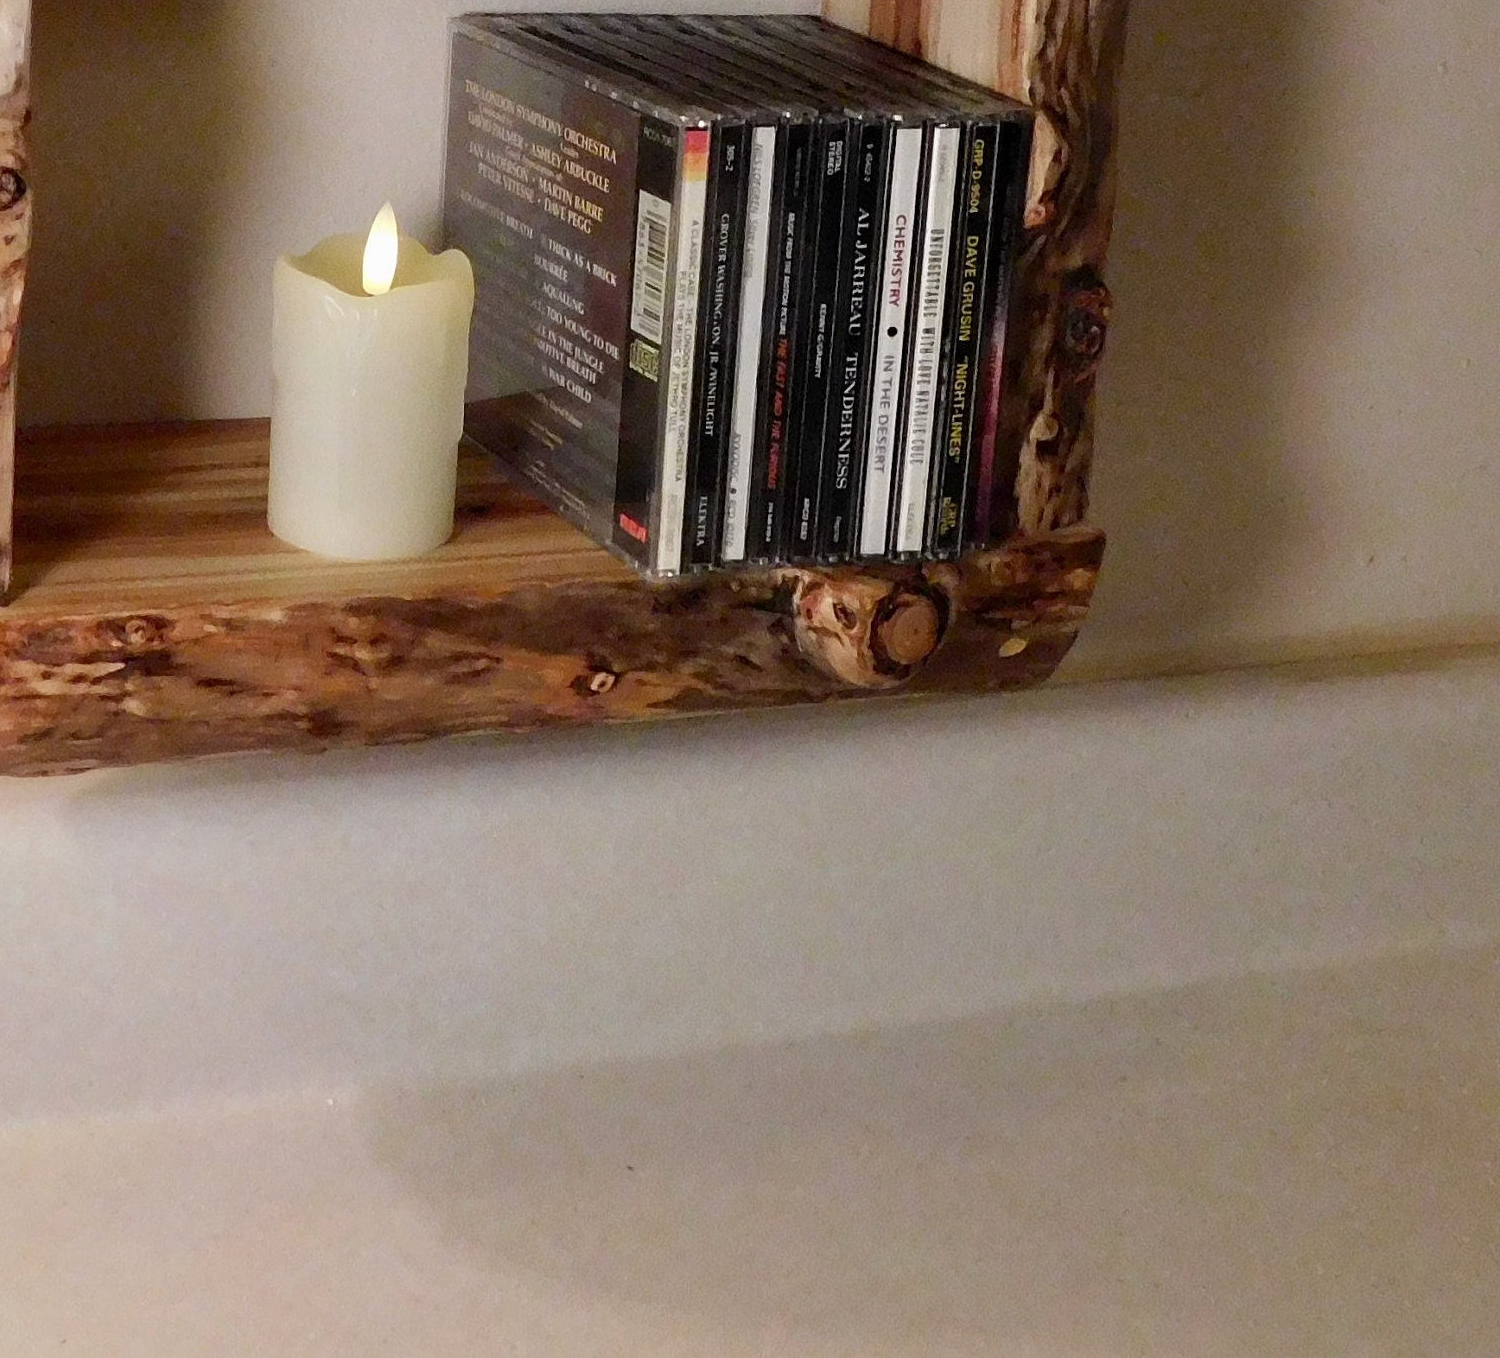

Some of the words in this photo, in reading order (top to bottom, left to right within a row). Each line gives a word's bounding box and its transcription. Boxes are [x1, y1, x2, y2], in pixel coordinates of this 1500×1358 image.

[482, 88, 515, 115] LONDON
[517, 103, 562, 136] SYMPHONY
[564, 127, 617, 164] ORCHESTRA
[493, 123, 524, 149] PALMER
[532, 144, 562, 167] ASHLEY
[563, 160, 610, 193] ARBUCKLE
[725, 145, 735, 172] 305-2
[826, 141, 836, 176] STEREO
[834, 141, 843, 173] DIGITAL
[969, 139, 985, 214] GRP-D-9504
[539, 177, 573, 206] MARTIN
[574, 196, 604, 222] BARRE
[544, 198, 567, 222] DAVE
[567, 210, 593, 235] PEGG
[786, 213, 796, 236] MUSIC
[856, 207, 870, 236] AL
[689, 229, 699, 269] CLASSIC
[718, 214, 730, 261] GROVER
[785, 238, 794, 259] FROM
[549, 239, 572, 262] THICK
[573, 252, 584, 267] AS
[586, 261, 591, 272] A
[592, 263, 618, 287] BRICK
[784, 261, 792, 274] THE
[889, 215, 907, 308] CHEMISTRY
[964, 236, 979, 278] DAVE
[677, 271, 688, 300] PLAYS
[686, 273, 696, 297] CASE
[848, 240, 868, 336] JARREAU
[923, 229, 945, 318] UNFORGETTABLE
[542, 282, 585, 315] AQUALUNG
[781, 276, 791, 306] MOTION
[676, 304, 686, 322] THE
[684, 307, 694, 326] THE
[779, 307, 789, 335] PICTURE
[818, 304, 827, 333] KENNY
[959, 281, 975, 341] GRUSIN
[547, 306, 562, 325] TOO
[564, 314, 592, 342] YOUNG
[593, 332, 604, 349] TO
[606, 341, 620, 361] DIE
[672, 324, 684, 354] MUSIC
[681, 329, 693, 368] LONDON
[920, 327, 935, 354] WITH
[558, 333, 574, 355] THE
[575, 343, 605, 374] JUNGLE
[672, 356, 681, 369] OF
[777, 338, 789, 361] THE
[883, 355, 895, 372] IN
[567, 358, 597, 384] BREATH
[776, 361, 786, 387] FAST
[917, 359, 932, 386] LOVE
[566, 378, 592, 404] CHILD
[670, 372, 681, 408] JETHRO
[677, 371, 690, 423] SYMPHONY
[774, 391, 784, 416] AND
[880, 377, 893, 408] THE
[669, 411, 679, 433] TULL
[835, 352, 859, 489] TENDERNESS
[913, 391, 930, 434] NATALIE
[770, 421, 781, 440] THE
[874, 415, 889, 474] DESERT
[675, 425, 686, 482] ORCHESTRA
[767, 442, 779, 490] FURIOUS
[909, 439, 926, 466] COLE
[696, 496, 708, 547] ELEKTRA
[948, 503, 957, 527] GRP
